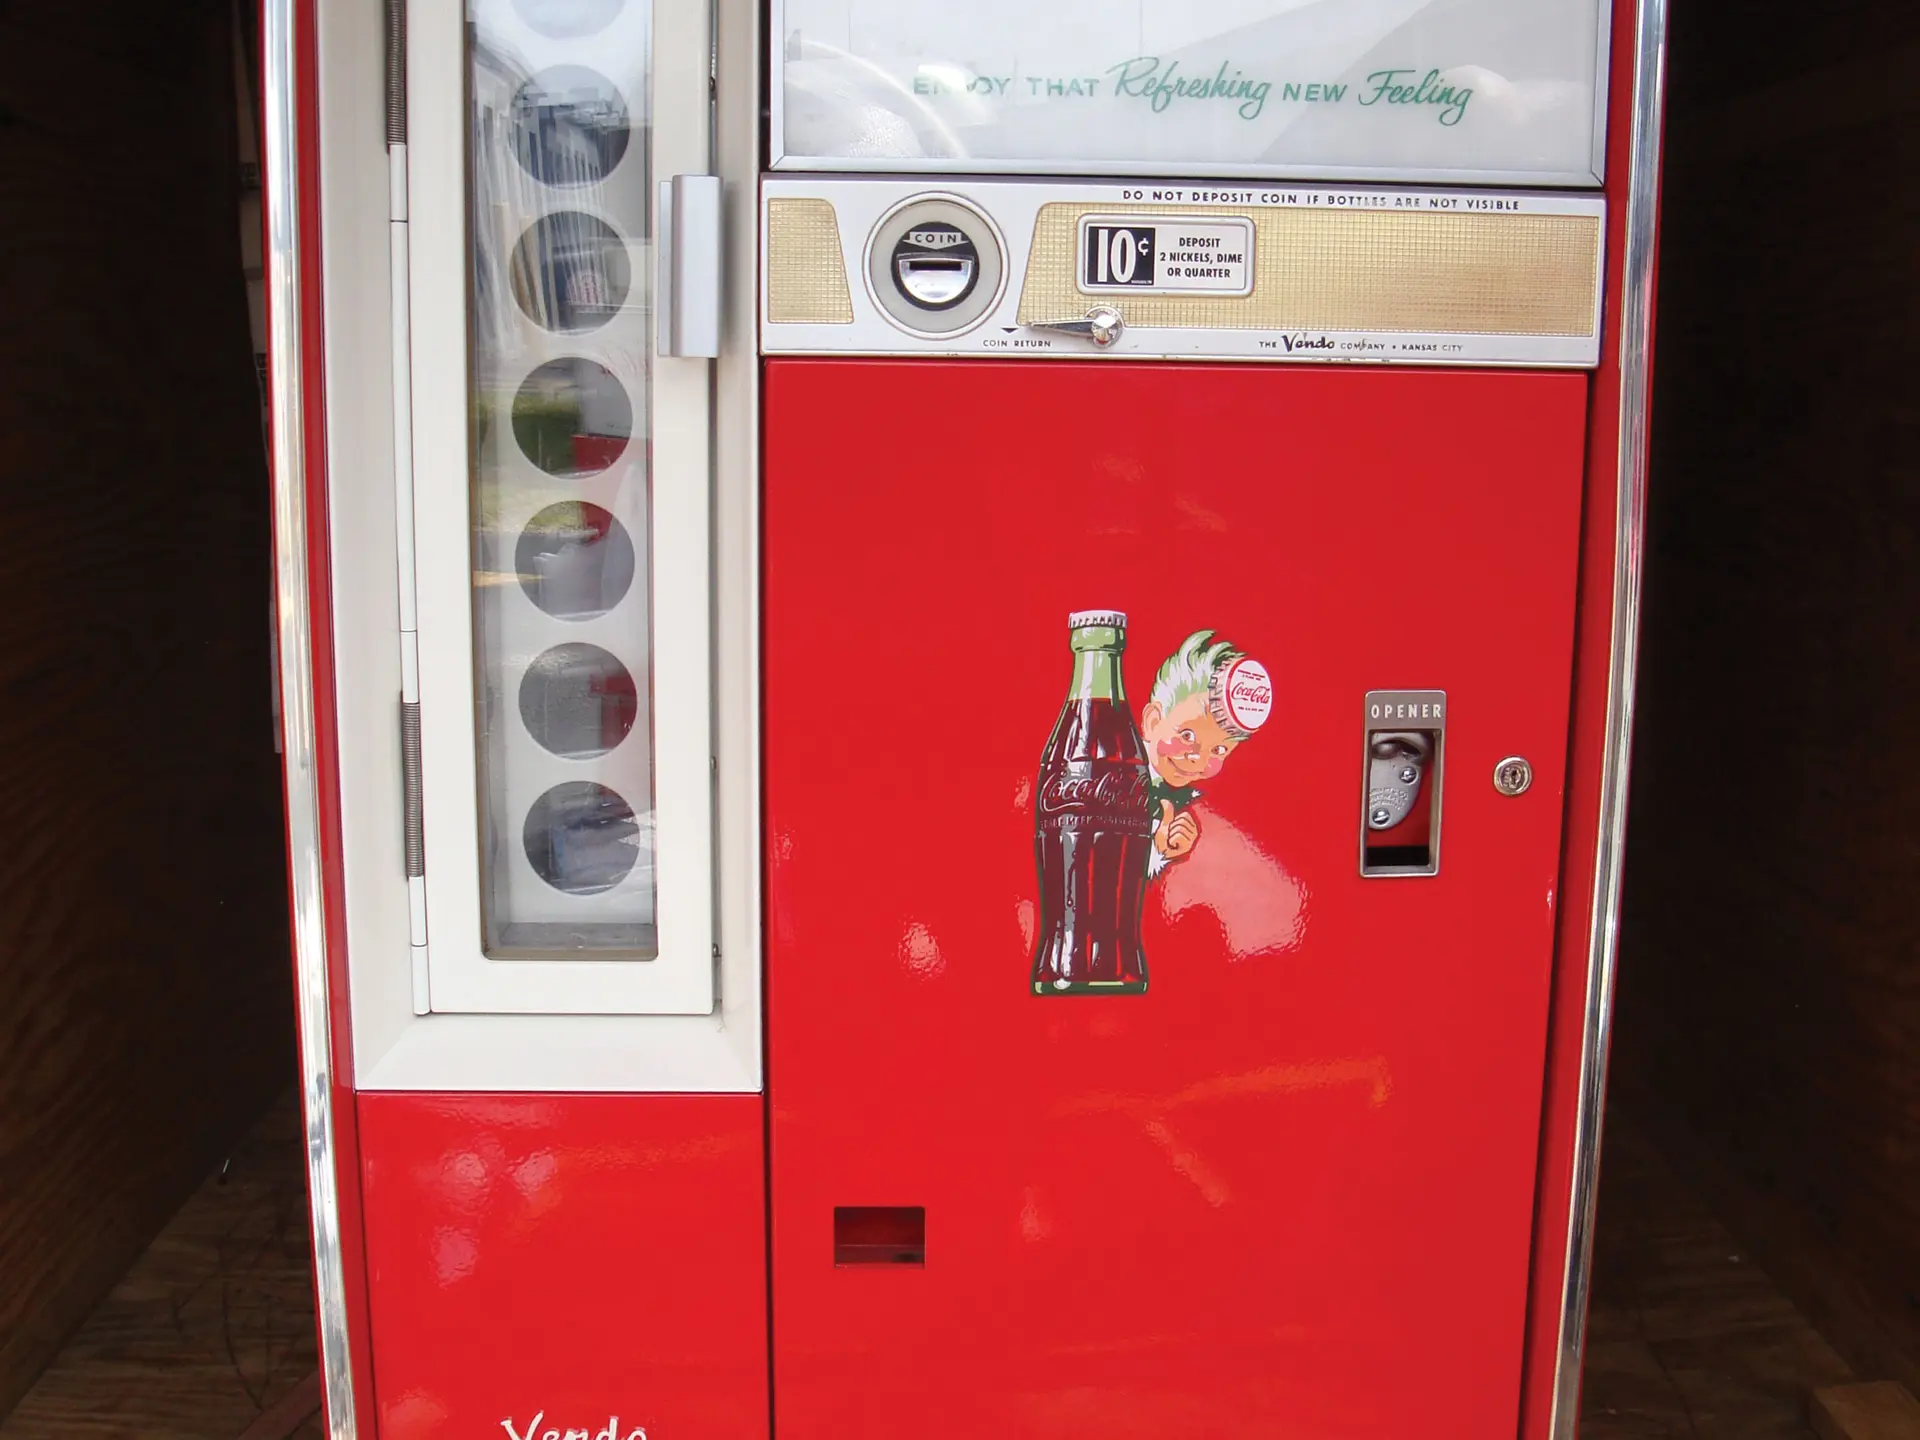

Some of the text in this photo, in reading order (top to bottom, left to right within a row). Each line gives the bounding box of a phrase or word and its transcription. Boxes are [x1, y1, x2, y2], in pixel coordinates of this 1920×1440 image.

[1026, 77, 1100, 96] THAT
[1105, 57, 1272, 121] Refreshing
[1282, 83, 1348, 102] NEW
[1358, 69, 1474, 127] Feeling
[1123, 190, 1519, 210] DO NOT DEPOSIT COIN IF BOTTLES ARE NOT VISIBLE
[914, 233, 957, 243] COIN
[1179, 237, 1221, 248] DEPOSIT
[1160, 252, 1243, 264] 2 NICKELS, DIME
[1167, 267, 1231, 278] OR QUARTER
[983, 339, 1051, 348] COIN RETURN
[1259, 341, 1277, 349] THE
[1281, 333, 1335, 353] Vendo
[1402, 344, 1437, 352] KANSAS
[1442, 344, 1463, 352] CITY
[1371, 704, 1442, 718] OPENER
